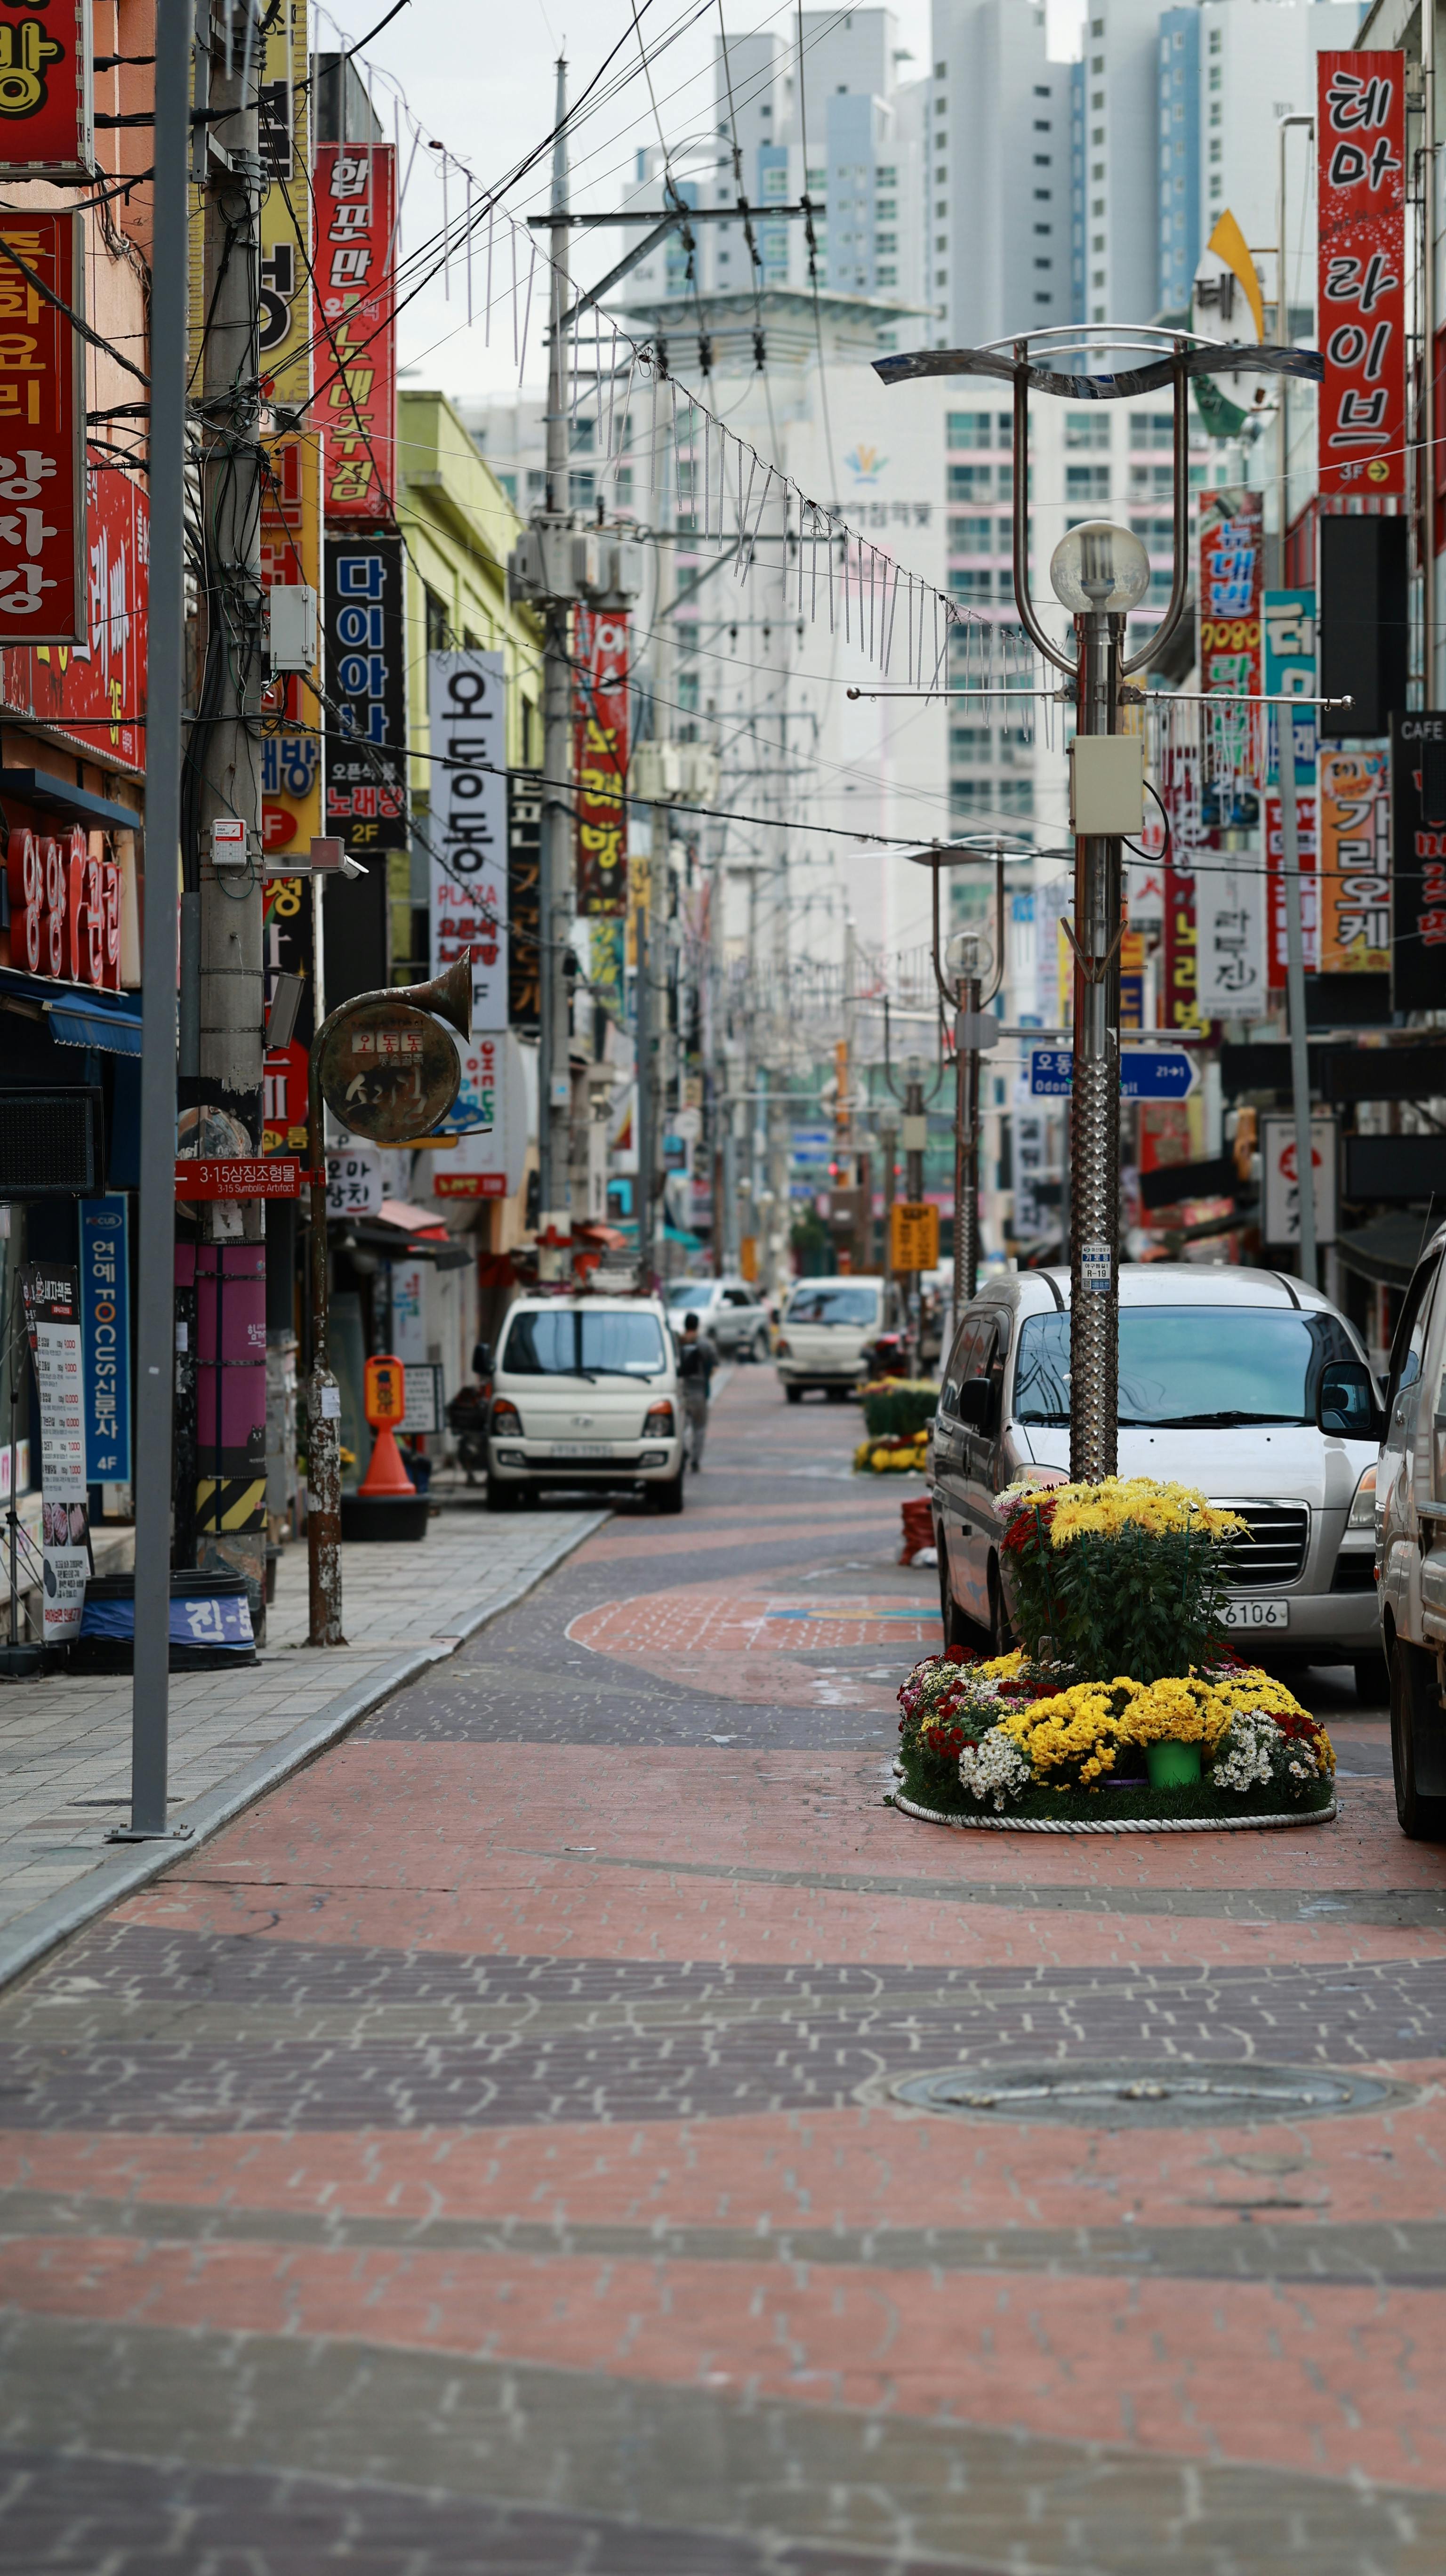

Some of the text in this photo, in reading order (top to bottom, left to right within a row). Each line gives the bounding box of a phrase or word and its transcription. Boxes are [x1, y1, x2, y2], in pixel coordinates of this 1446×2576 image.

[329, 158, 370, 289] 합포만
[0, 231, 46, 423] 중화요리
[1325, 254, 1397, 446] 라이브
[329, 322, 373, 502] 노래주점
[1340, 464, 1363, 480] 3F
[0, 451, 56, 613] 양자강
[337, 556, 387, 745] 다이아나
[1401, 720, 1444, 740] CAFE
[442, 671, 493, 872] 오동동
[327, 786, 405, 819] 노래방
[352, 824, 379, 843] 2F
[1331, 797, 1390, 951] 가라오케
[438, 885, 497, 906] PLAZA
[438, 918, 496, 940] 오픈식
[357, 1034, 423, 1053] 오동동
[200, 1165, 296, 1183] 3·15상징조형물
[235, 1183, 265, 1194] Symbolic
[266, 1183, 295, 1192] Artifact
[93, 1240, 115, 1283] 연예
[97, 1456, 117, 1470] 4F
[1225, 1605, 1277, 1623] 6106
